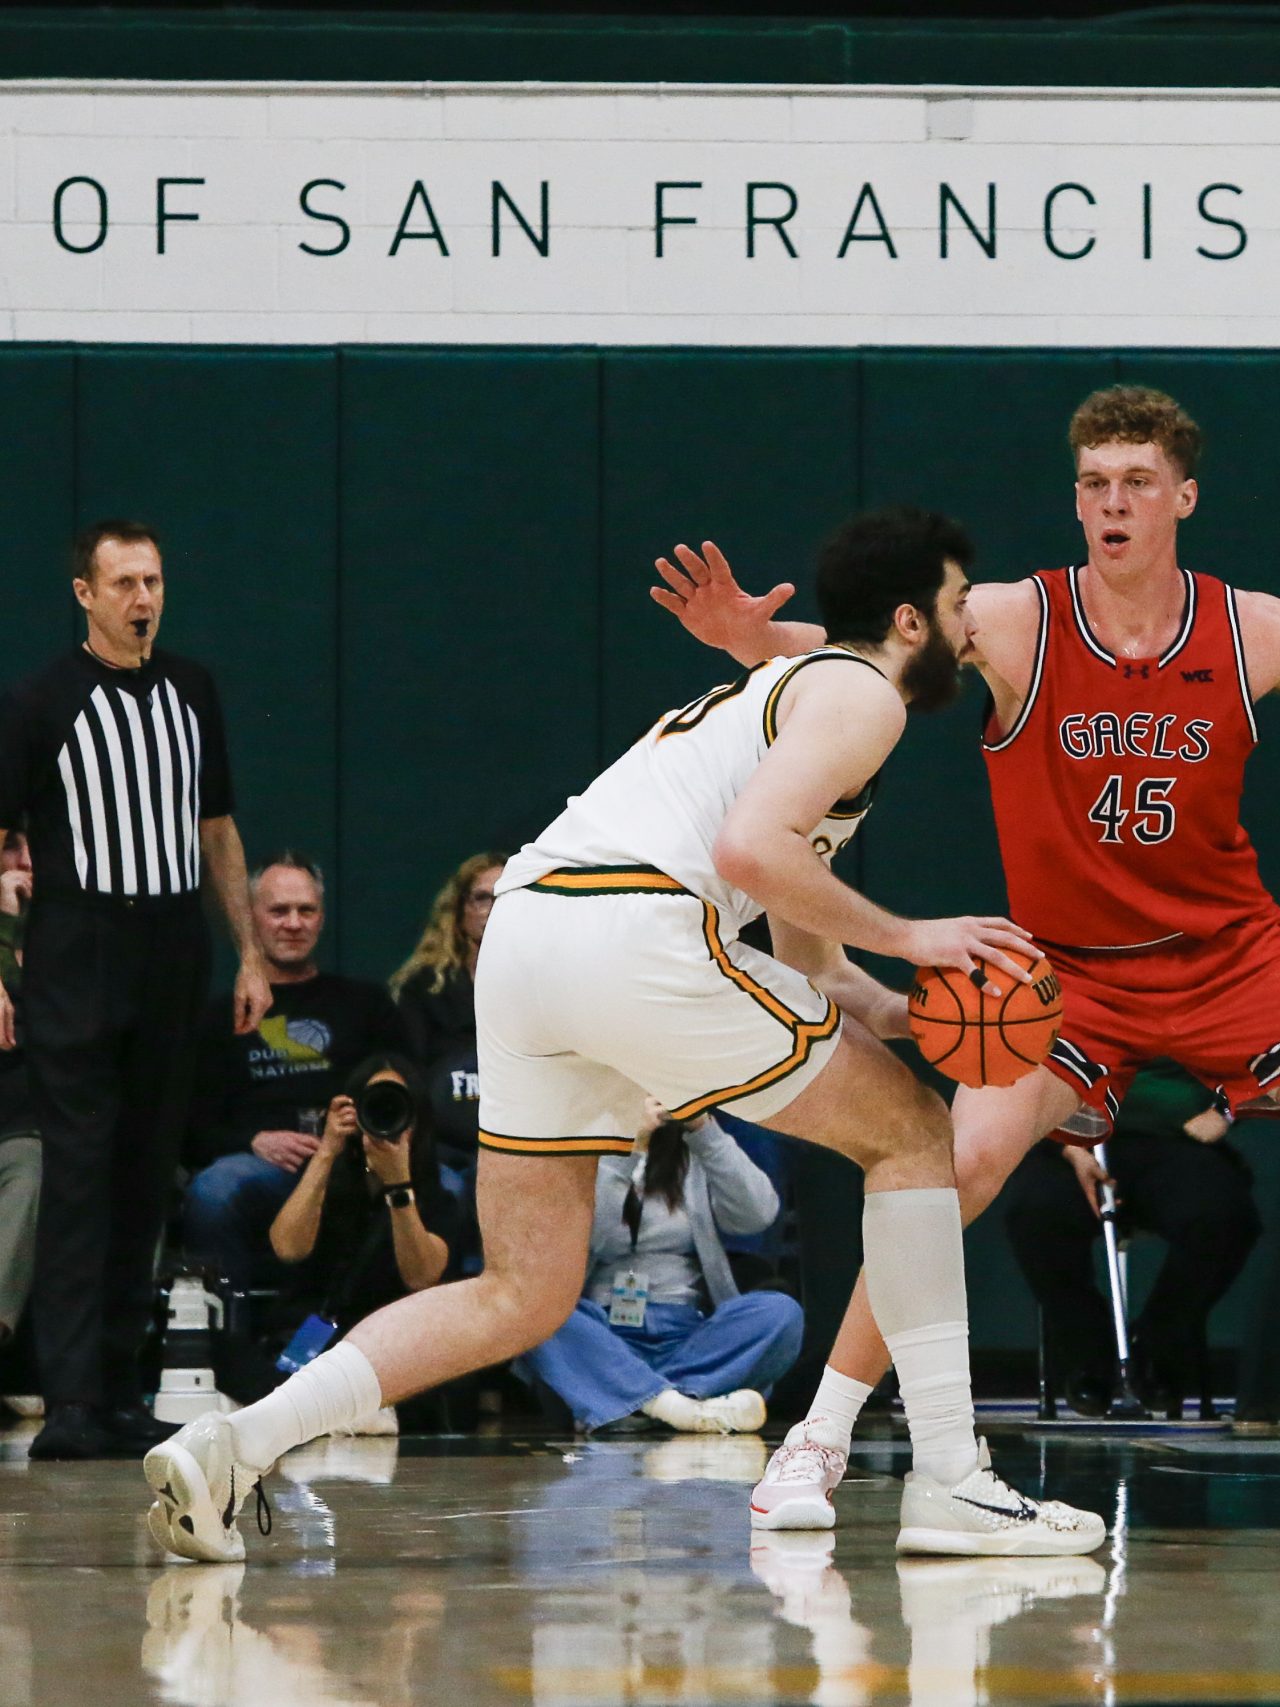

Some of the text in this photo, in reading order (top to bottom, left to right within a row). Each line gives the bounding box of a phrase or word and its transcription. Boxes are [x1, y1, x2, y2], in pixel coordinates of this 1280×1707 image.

[52, 176, 206, 255] OF
[298, 178, 550, 258] SAN
[1059, 711, 1214, 763] GAELS
[1087, 774, 1177, 846] 45
